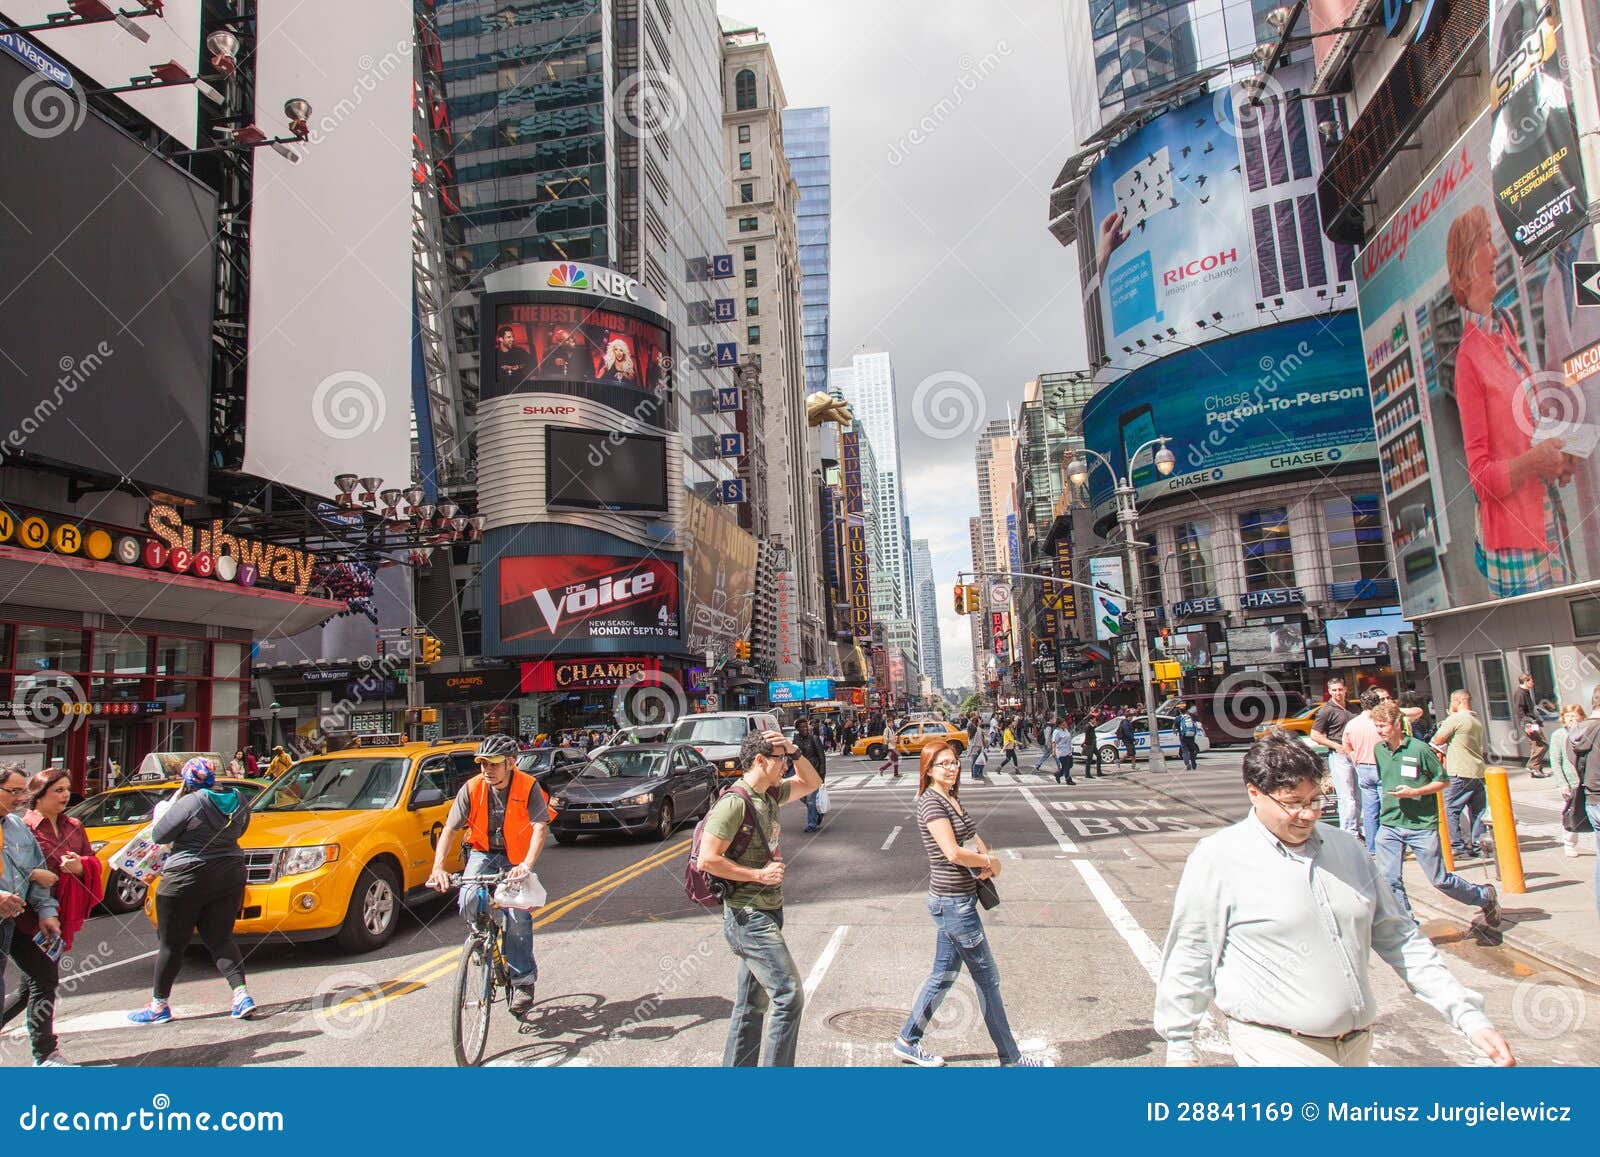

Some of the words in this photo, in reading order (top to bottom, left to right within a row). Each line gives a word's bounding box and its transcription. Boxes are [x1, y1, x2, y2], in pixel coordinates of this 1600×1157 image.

[16, 36, 67, 81] Wagner
[1497, 28, 1545, 102] SPY
[1500, 185, 1513, 200] THE
[1513, 165, 1540, 191] SECRET
[1541, 147, 1568, 171] WORLD
[1510, 192, 1520, 205] OF
[1520, 164, 1561, 198] ESPIONAGE
[1361, 147, 1474, 281] Walgreens
[1163, 248, 1238, 286] RICOH
[1203, 265, 1241, 283] change.
[592, 271, 640, 301] NBC
[512, 306, 538, 322] THE
[540, 307, 577, 323] BEST
[1564, 344, 1600, 378] LINCO
[523, 406, 576, 415] SHARP
[1204, 389, 1250, 412] Chase
[1206, 386, 1364, 425] Person-To-Person
[1270, 451, 1324, 469] CHASE
[1169, 471, 1209, 489] CHASE
[27, 522, 44, 542] Q
[62, 528, 76, 548] R
[123, 540, 136, 559] S
[177, 551, 188, 569] 2
[200, 556, 211, 574] 3
[245, 566, 254, 582] 7
[148, 504, 316, 595] Subway
[566, 583, 586, 595] the
[851, 526, 868, 636] TUSSAUDS
[532, 571, 655, 635] Voice
[1063, 594, 1075, 617] NEW
[1174, 599, 1217, 616] HASE
[1240, 588, 1301, 608] CHASE
[658, 604, 669, 623] 4
[589, 627, 631, 636] MONDAY
[633, 627, 653, 636] SEPT
[655, 628, 664, 636] 10
[321, 671, 349, 680] Wagner
[556, 663, 646, 686] CHAMPS
[1050, 799, 1168, 812] ONLY
[1069, 816, 1201, 837] BUS
